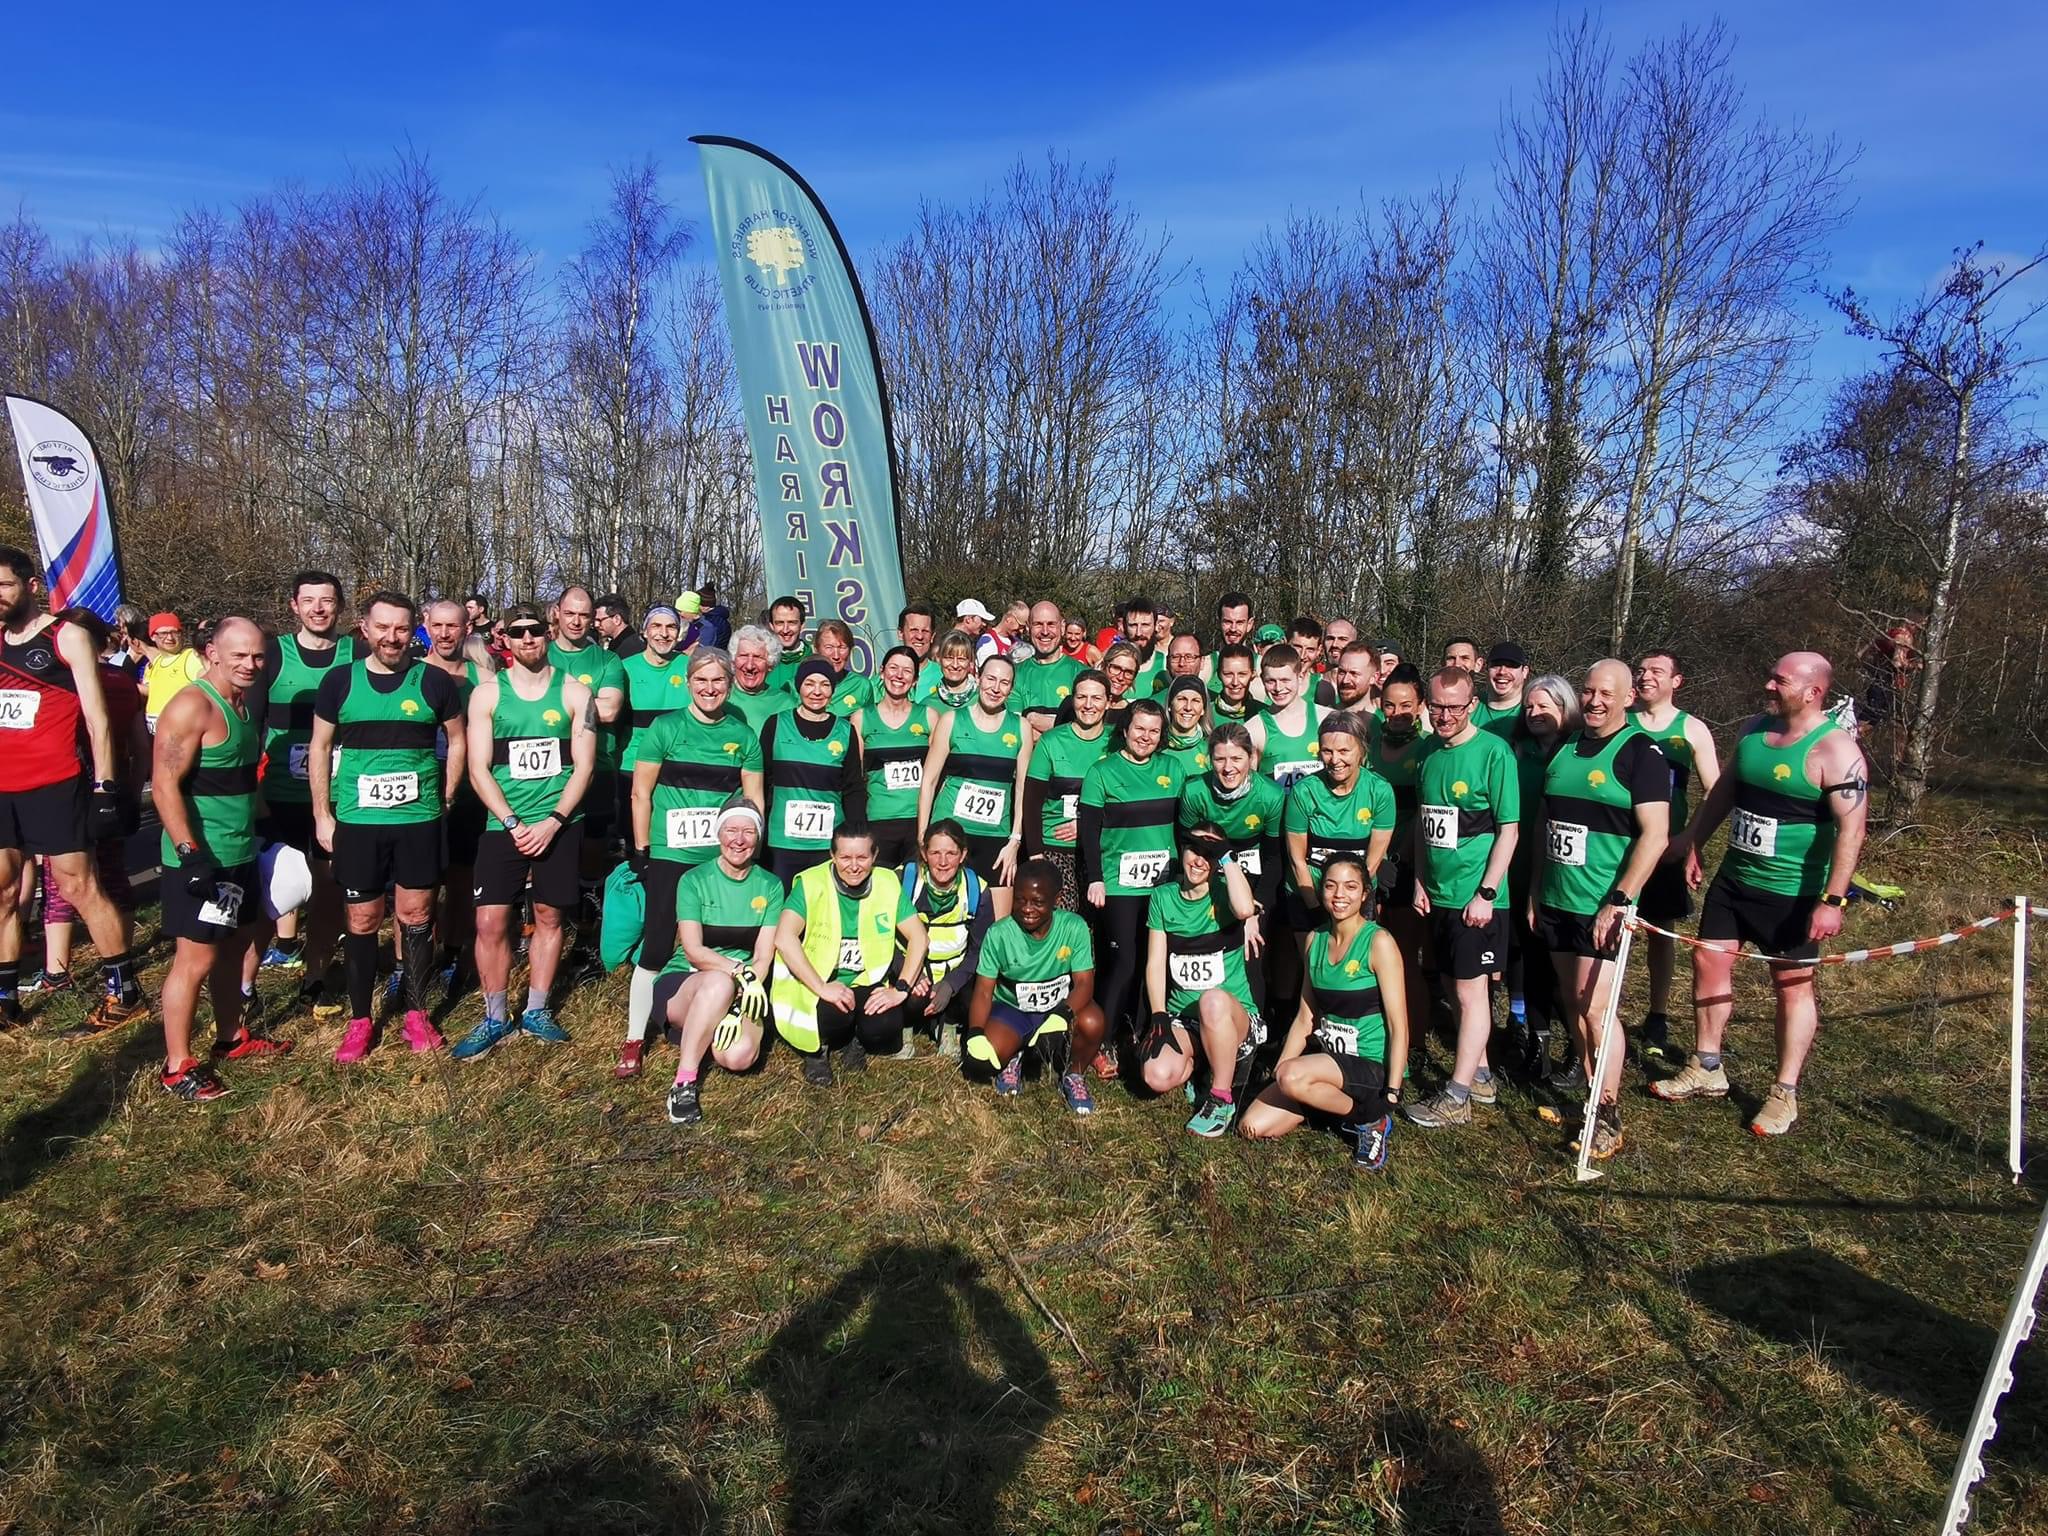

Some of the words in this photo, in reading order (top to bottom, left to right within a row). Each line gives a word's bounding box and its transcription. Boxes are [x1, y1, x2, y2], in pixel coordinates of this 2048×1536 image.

[518, 750, 551, 770] 407
[891, 766, 920, 782] 420
[369, 784, 407, 801] 433
[965, 795, 996, 817] 429
[677, 819, 712, 839] 412
[794, 812, 824, 831] 471
[1733, 820, 1762, 847] 416
[1128, 862, 1161, 881] 495
[1179, 961, 1213, 982] 485
[1028, 986, 1061, 1007] 459
